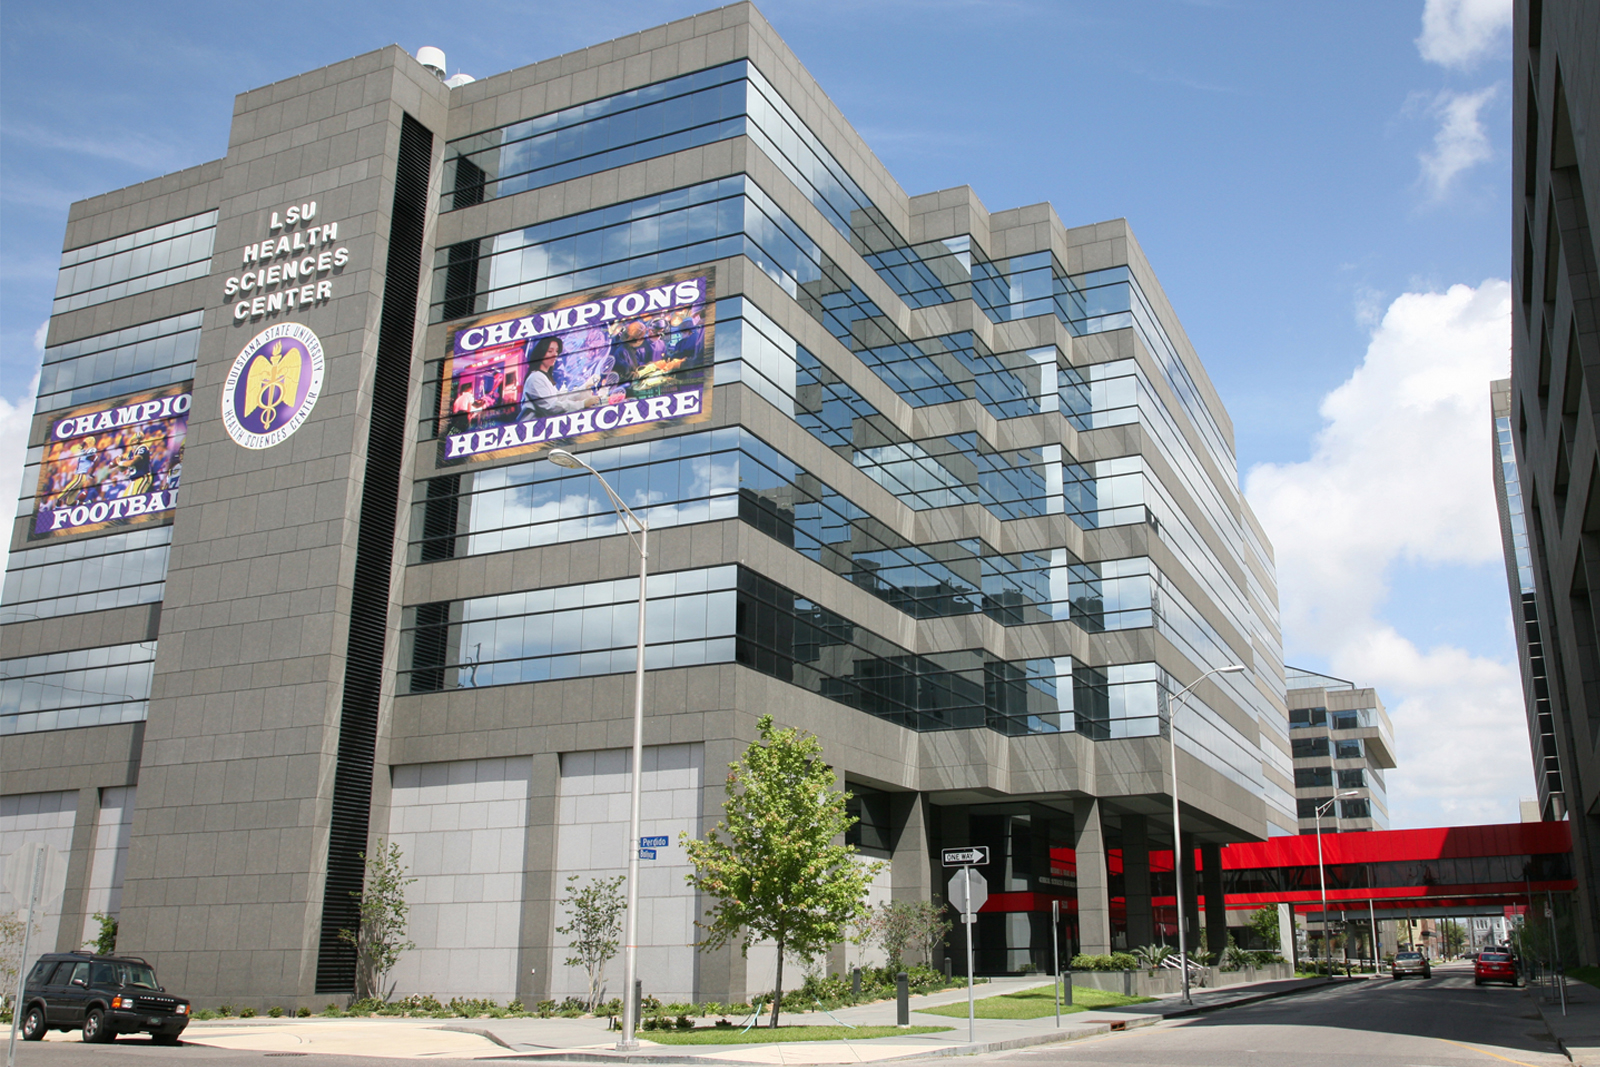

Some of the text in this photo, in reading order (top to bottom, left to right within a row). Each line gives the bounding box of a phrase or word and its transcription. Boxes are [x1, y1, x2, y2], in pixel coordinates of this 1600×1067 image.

[270, 201, 317, 230] LSU
[243, 221, 338, 264] HEALTH
[224, 247, 349, 296] SCIENCES
[234, 280, 332, 320] CENTER
[460, 280, 700, 351] CHAMPIONS
[225, 325, 323, 391] LOUISIANA STATE UNIVERSITY
[56, 393, 192, 439] CHAMPIO
[224, 391, 317, 448] HEALTH SCIENCES CENTER
[447, 389, 700, 458] HEALTHCARE
[642, 837, 666, 847] Perdido
[946, 853, 960, 861] ONE
